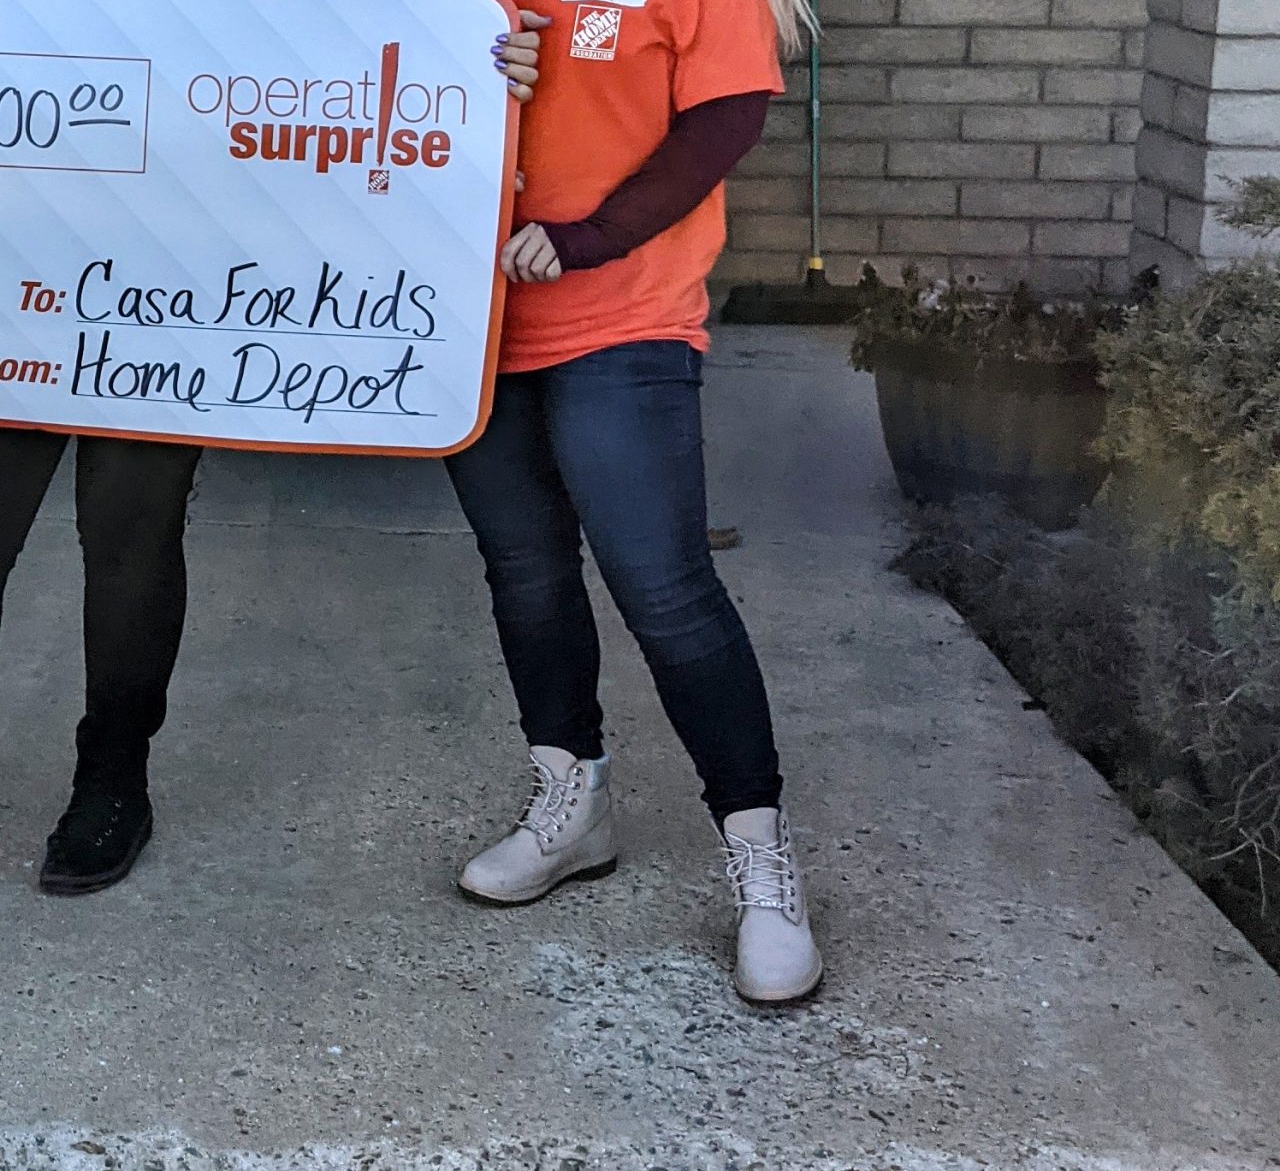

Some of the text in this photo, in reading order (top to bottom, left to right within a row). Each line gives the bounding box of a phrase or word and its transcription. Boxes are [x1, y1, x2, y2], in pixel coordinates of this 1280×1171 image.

[574, 8, 620, 48] HOME
[18, 279, 67, 315] To:
[75, 258, 206, 325] Casa
[71, 329, 212, 412] Home
[226, 341, 425, 424] Depot
